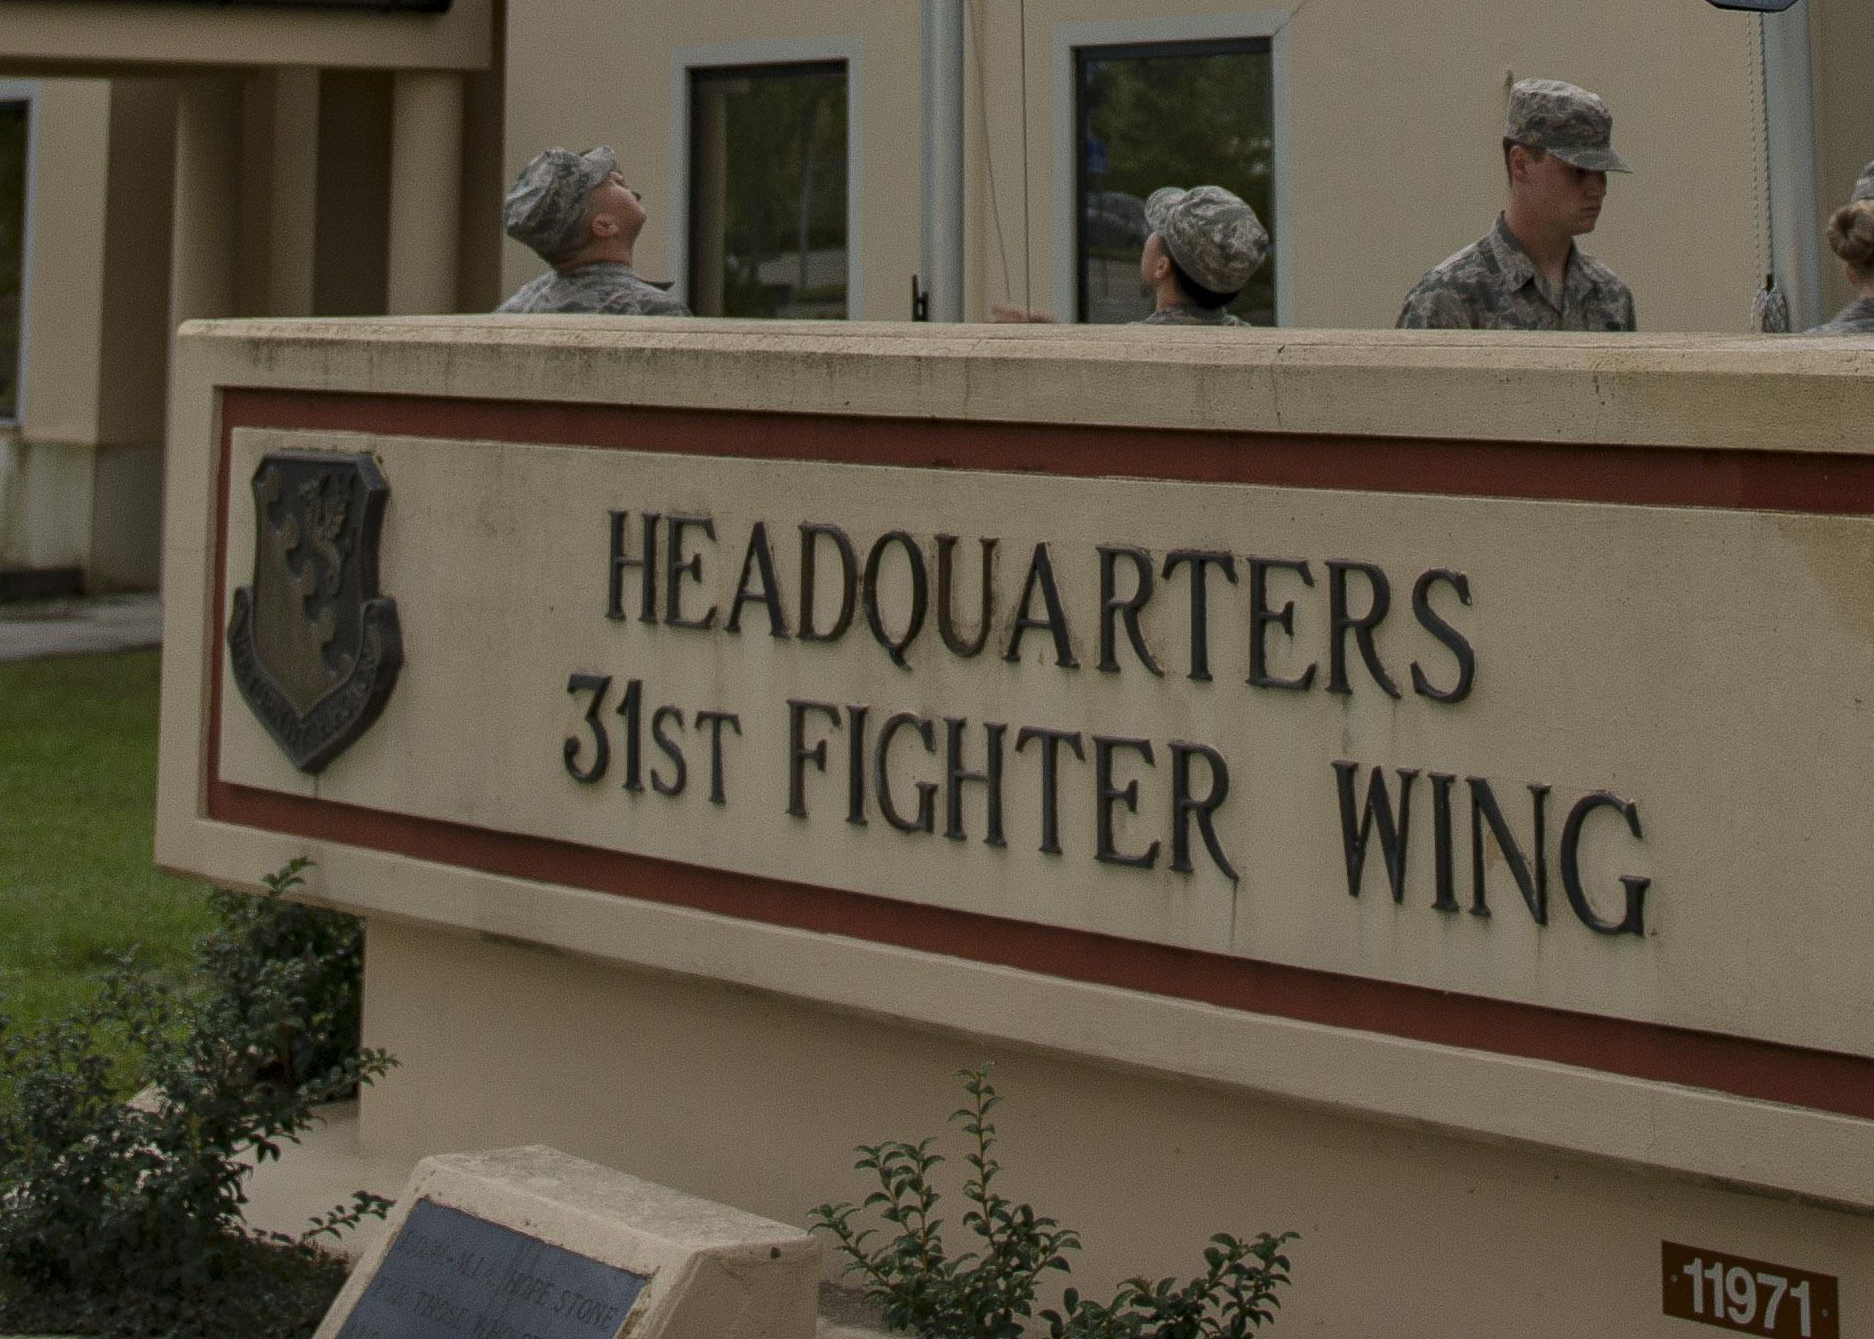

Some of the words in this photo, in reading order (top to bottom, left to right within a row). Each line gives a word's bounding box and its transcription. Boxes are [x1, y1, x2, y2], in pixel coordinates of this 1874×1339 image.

[606, 510, 1477, 705] HEADQUARTERS
[562, 673, 742, 809] 31ST
[786, 699, 1240, 885] FIGHTER
[1331, 761, 1652, 941] WING
[501, 1268, 557, 1307] HOPE
[553, 1288, 620, 1331] STONE
[1683, 1257, 1812, 1338] 11971
